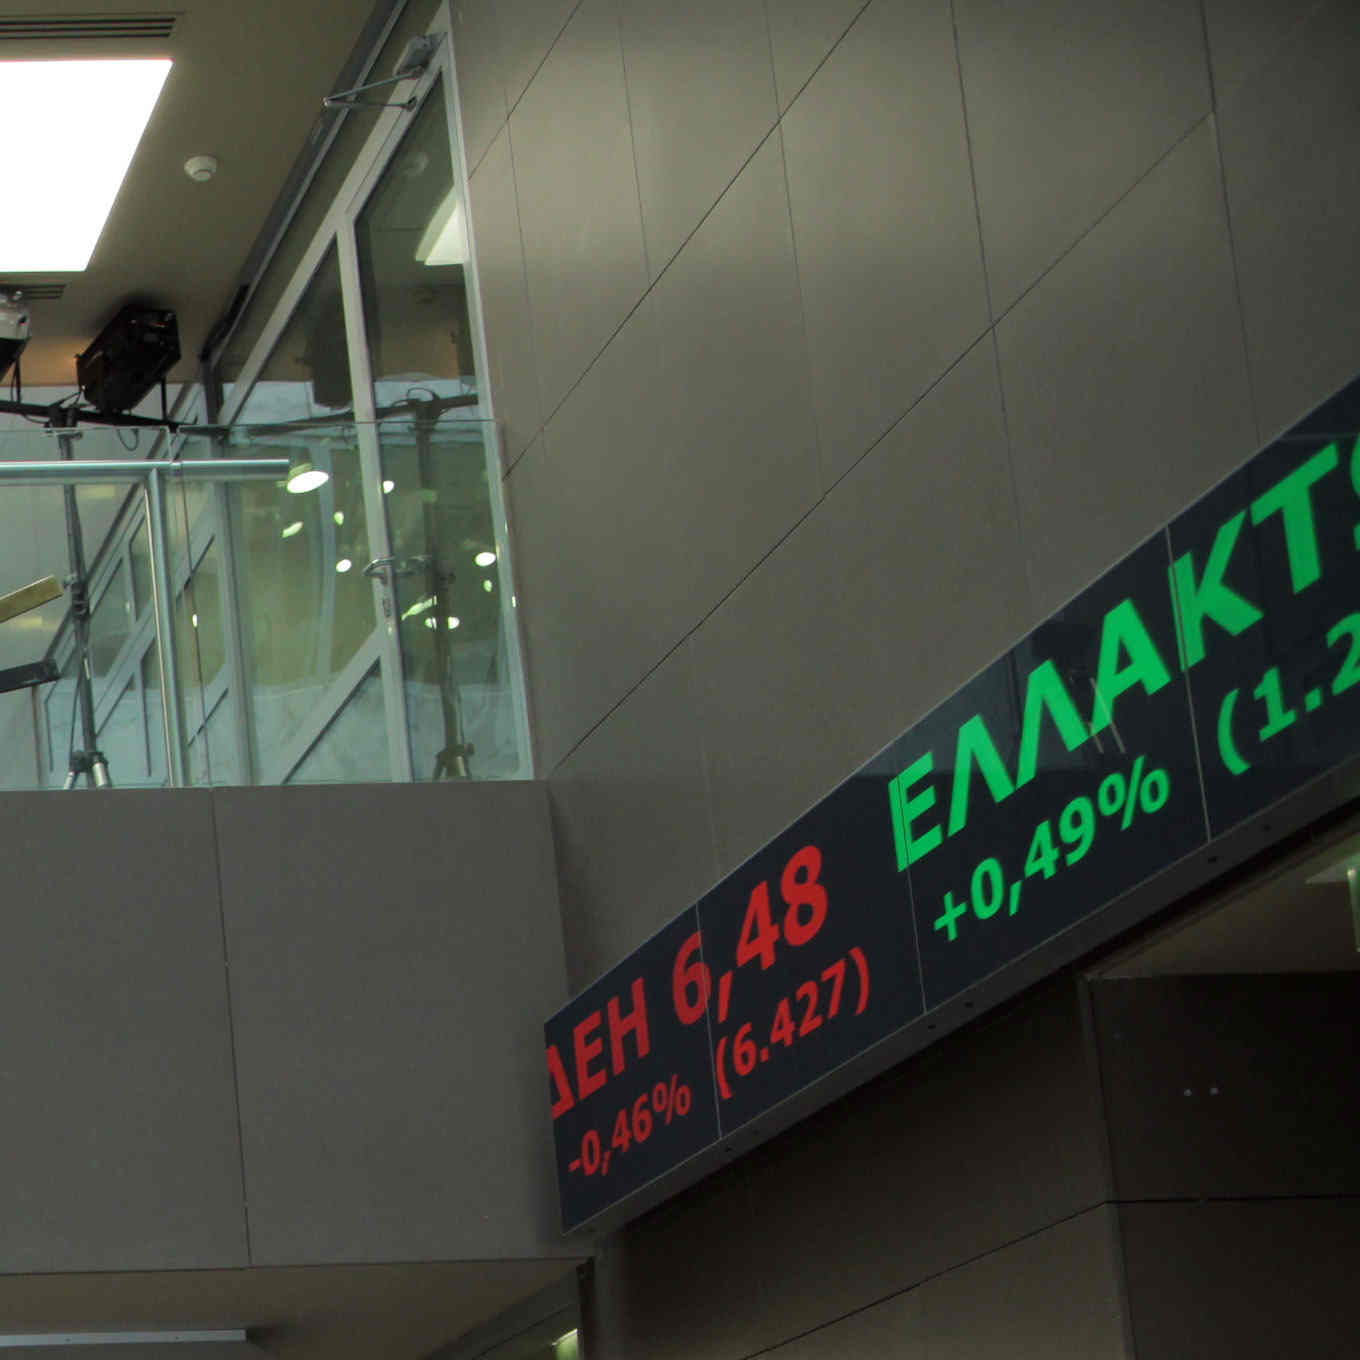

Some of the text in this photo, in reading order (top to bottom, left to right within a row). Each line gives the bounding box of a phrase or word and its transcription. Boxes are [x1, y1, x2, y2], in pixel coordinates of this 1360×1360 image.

[567, 1072, 693, 1178] -0,46%
[715, 945, 872, 1101] (6.427)
[934, 754, 1173, 942] +0,49%
[672, 844, 830, 1026] 6,48
[886, 432, 1360, 874] ΕΛΛΑΚΤ
